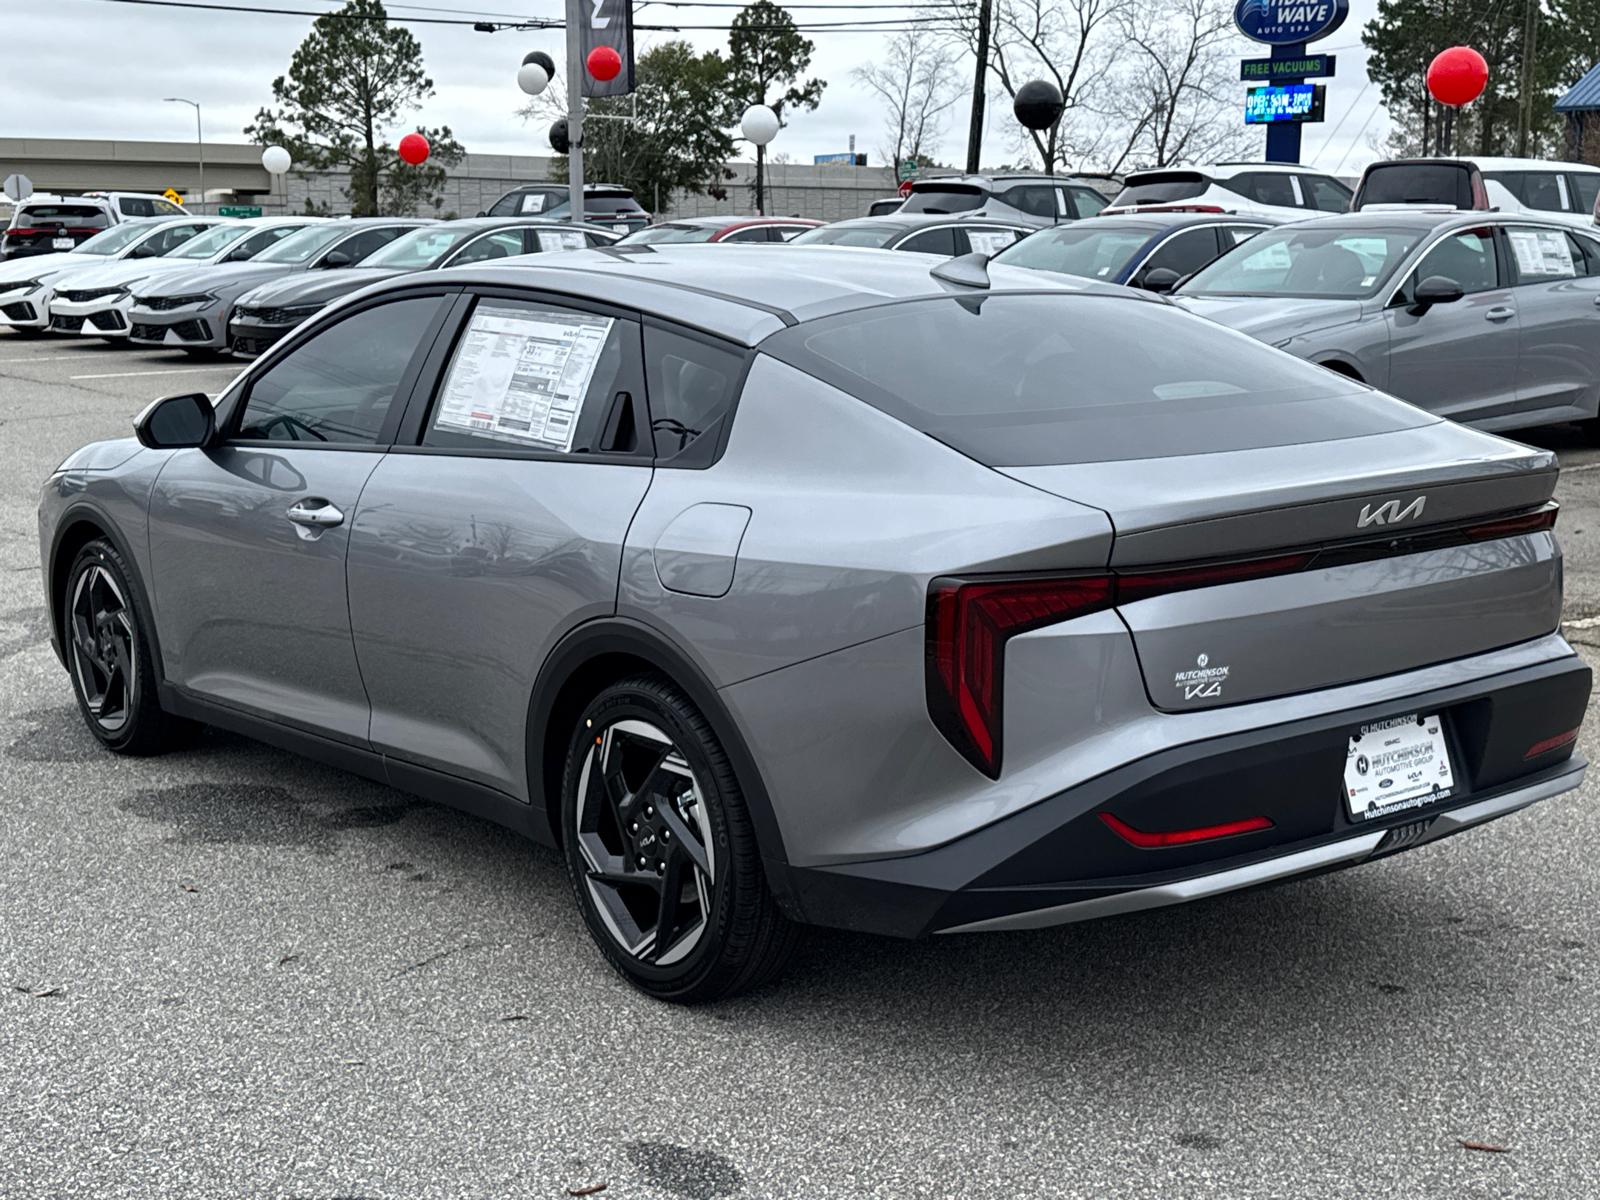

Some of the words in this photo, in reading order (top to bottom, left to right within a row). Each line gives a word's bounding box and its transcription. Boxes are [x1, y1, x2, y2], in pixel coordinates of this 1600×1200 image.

[1277, 4, 1328, 24] WAVE
[1256, 26, 1283, 34] AUTO
[1289, 25, 1310, 33] SPA
[1245, 63, 1270, 76] FREE
[1271, 59, 1321, 74] VACUUMS
[1356, 495, 1427, 529] KIA
[1175, 666, 1229, 681] HUTCHINSON
[1369, 713, 1418, 733] HUTCHINSON
[1371, 740, 1434, 770] HUTCHINSON
[1375, 760, 1413, 778] AUTOMOTIVE
[1413, 754, 1434, 767] GROUP
[1363, 789, 1452, 820] Hutchinsonautogroup.com
